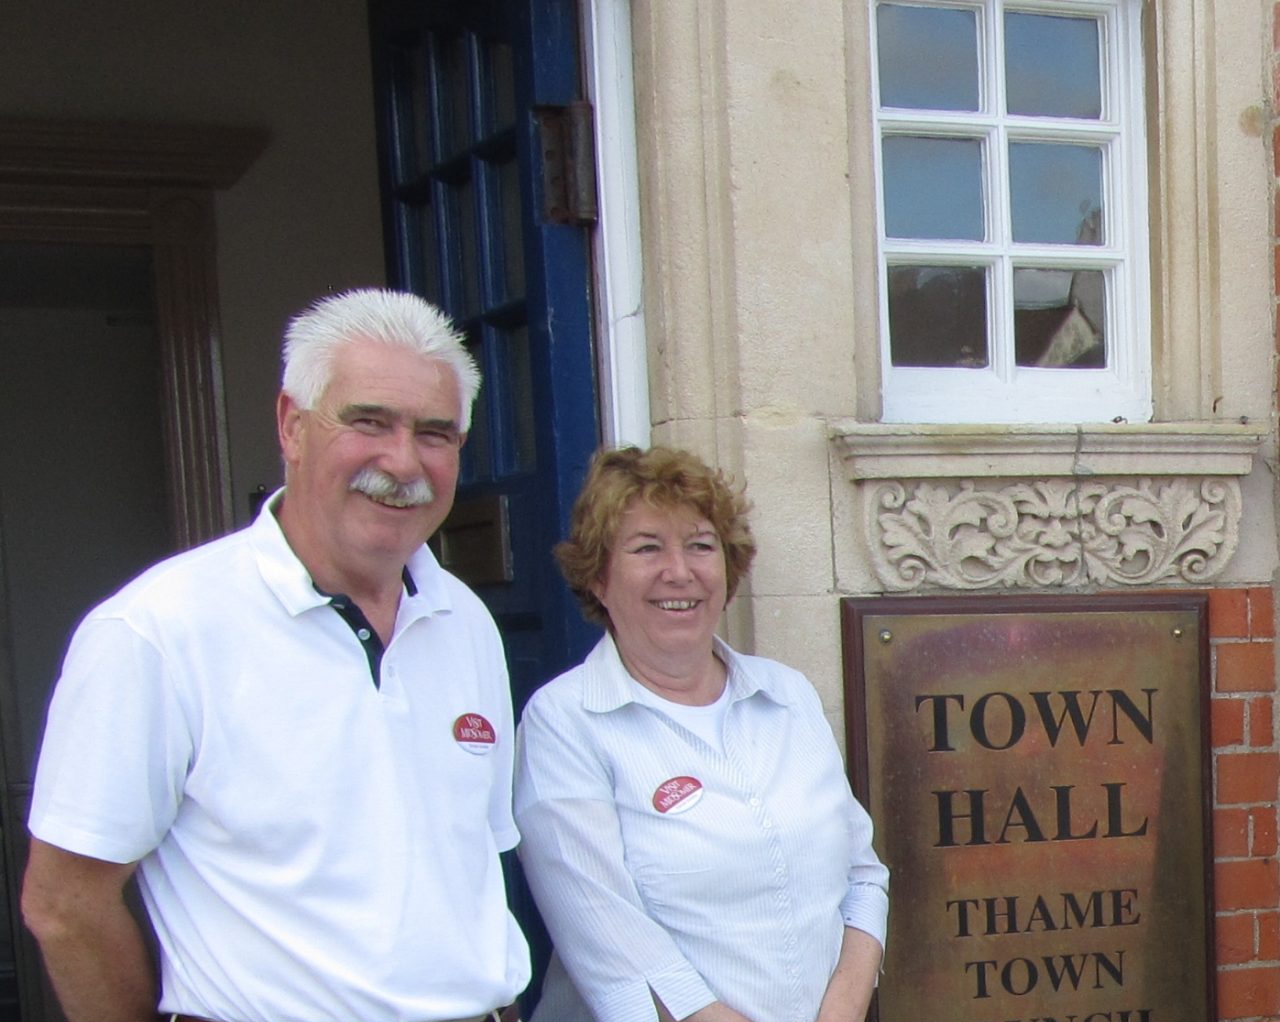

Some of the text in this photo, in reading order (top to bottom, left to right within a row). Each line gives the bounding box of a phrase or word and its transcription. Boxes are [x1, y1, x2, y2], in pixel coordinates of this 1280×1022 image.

[915, 688, 1158, 752] TOWN
[932, 782, 1149, 847] HALL
[946, 889, 1142, 938] THAME
[965, 951, 1126, 999] TOWN
